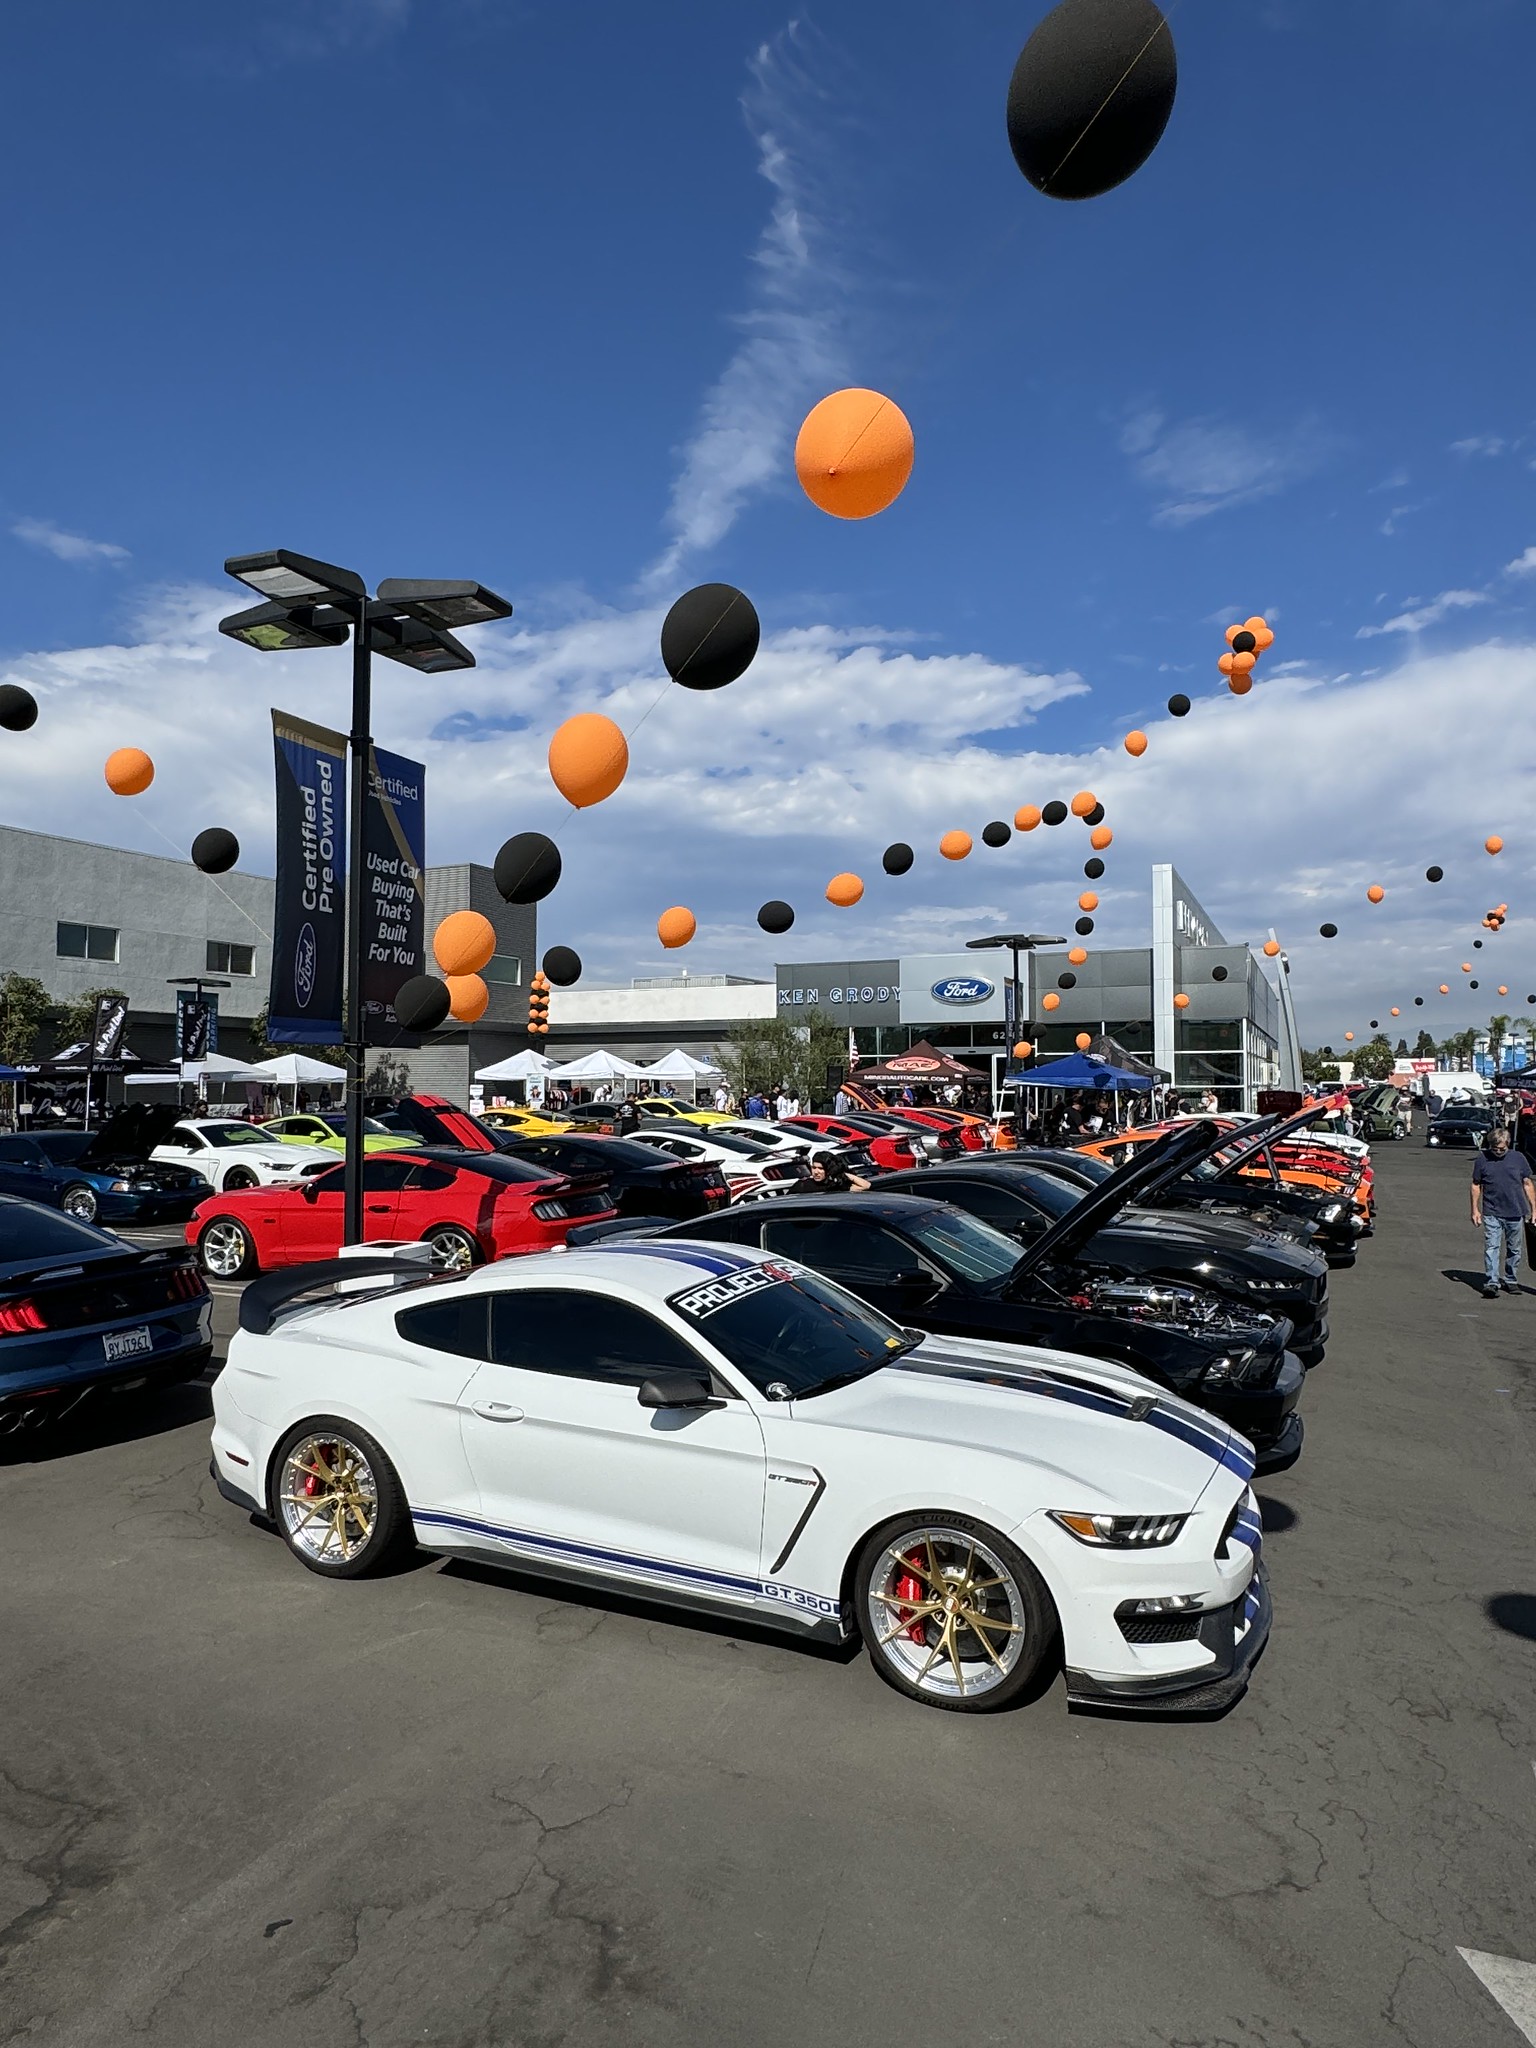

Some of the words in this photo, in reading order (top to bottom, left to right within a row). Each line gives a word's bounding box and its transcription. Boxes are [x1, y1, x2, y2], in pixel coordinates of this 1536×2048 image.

[316, 759, 334, 861] Owned
[299, 785, 317, 911] Certified
[366, 852, 399, 875] Used
[400, 860, 420, 880] Car
[319, 867, 334, 914] Pre
[371, 875, 415, 903] Buying
[375, 899, 412, 922] That's
[378, 922, 407, 942] Built
[297, 938, 313, 992] Ford
[368, 942, 391, 962] For
[393, 946, 415, 965] You
[778, 988, 819, 1004] KEN
[829, 986, 901, 1004] GRODY
[943, 981, 979, 997] Ford
[677, 1267, 775, 1316] PROJECT
